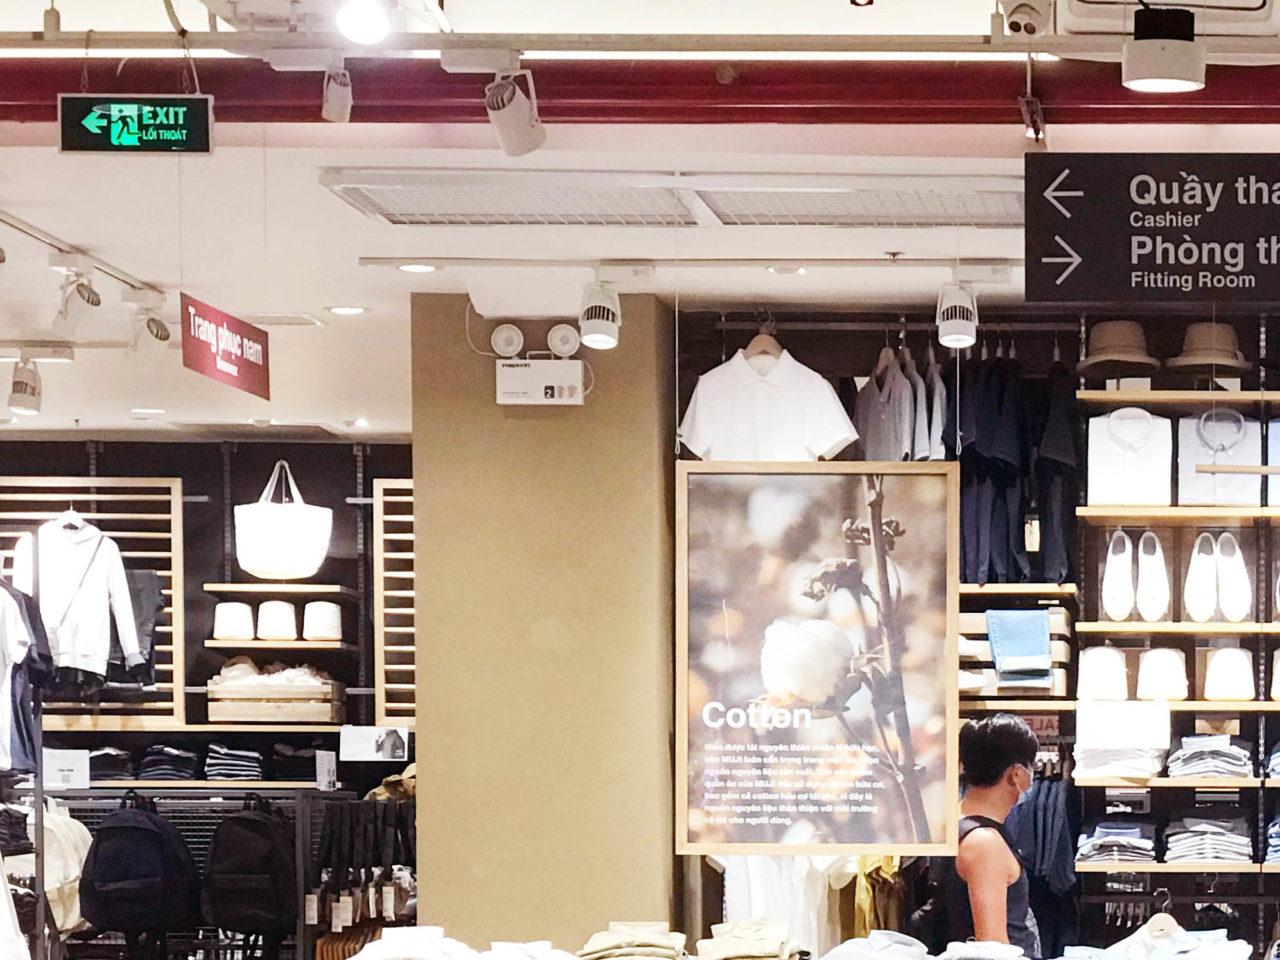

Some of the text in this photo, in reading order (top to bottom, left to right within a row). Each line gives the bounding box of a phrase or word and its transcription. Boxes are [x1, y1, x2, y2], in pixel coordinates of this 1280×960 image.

[142, 106, 187, 124] EXIT
[158, 127, 187, 140] THOÁT
[1129, 171, 1224, 212] Quầy
[1129, 211, 1202, 227] Cashier
[1130, 234, 1245, 272] Phòng
[1130, 271, 1256, 291] Fitting Room
[188, 305, 217, 354] Trang
[243, 337, 263, 366] nam
[702, 701, 812, 729] Cotton
